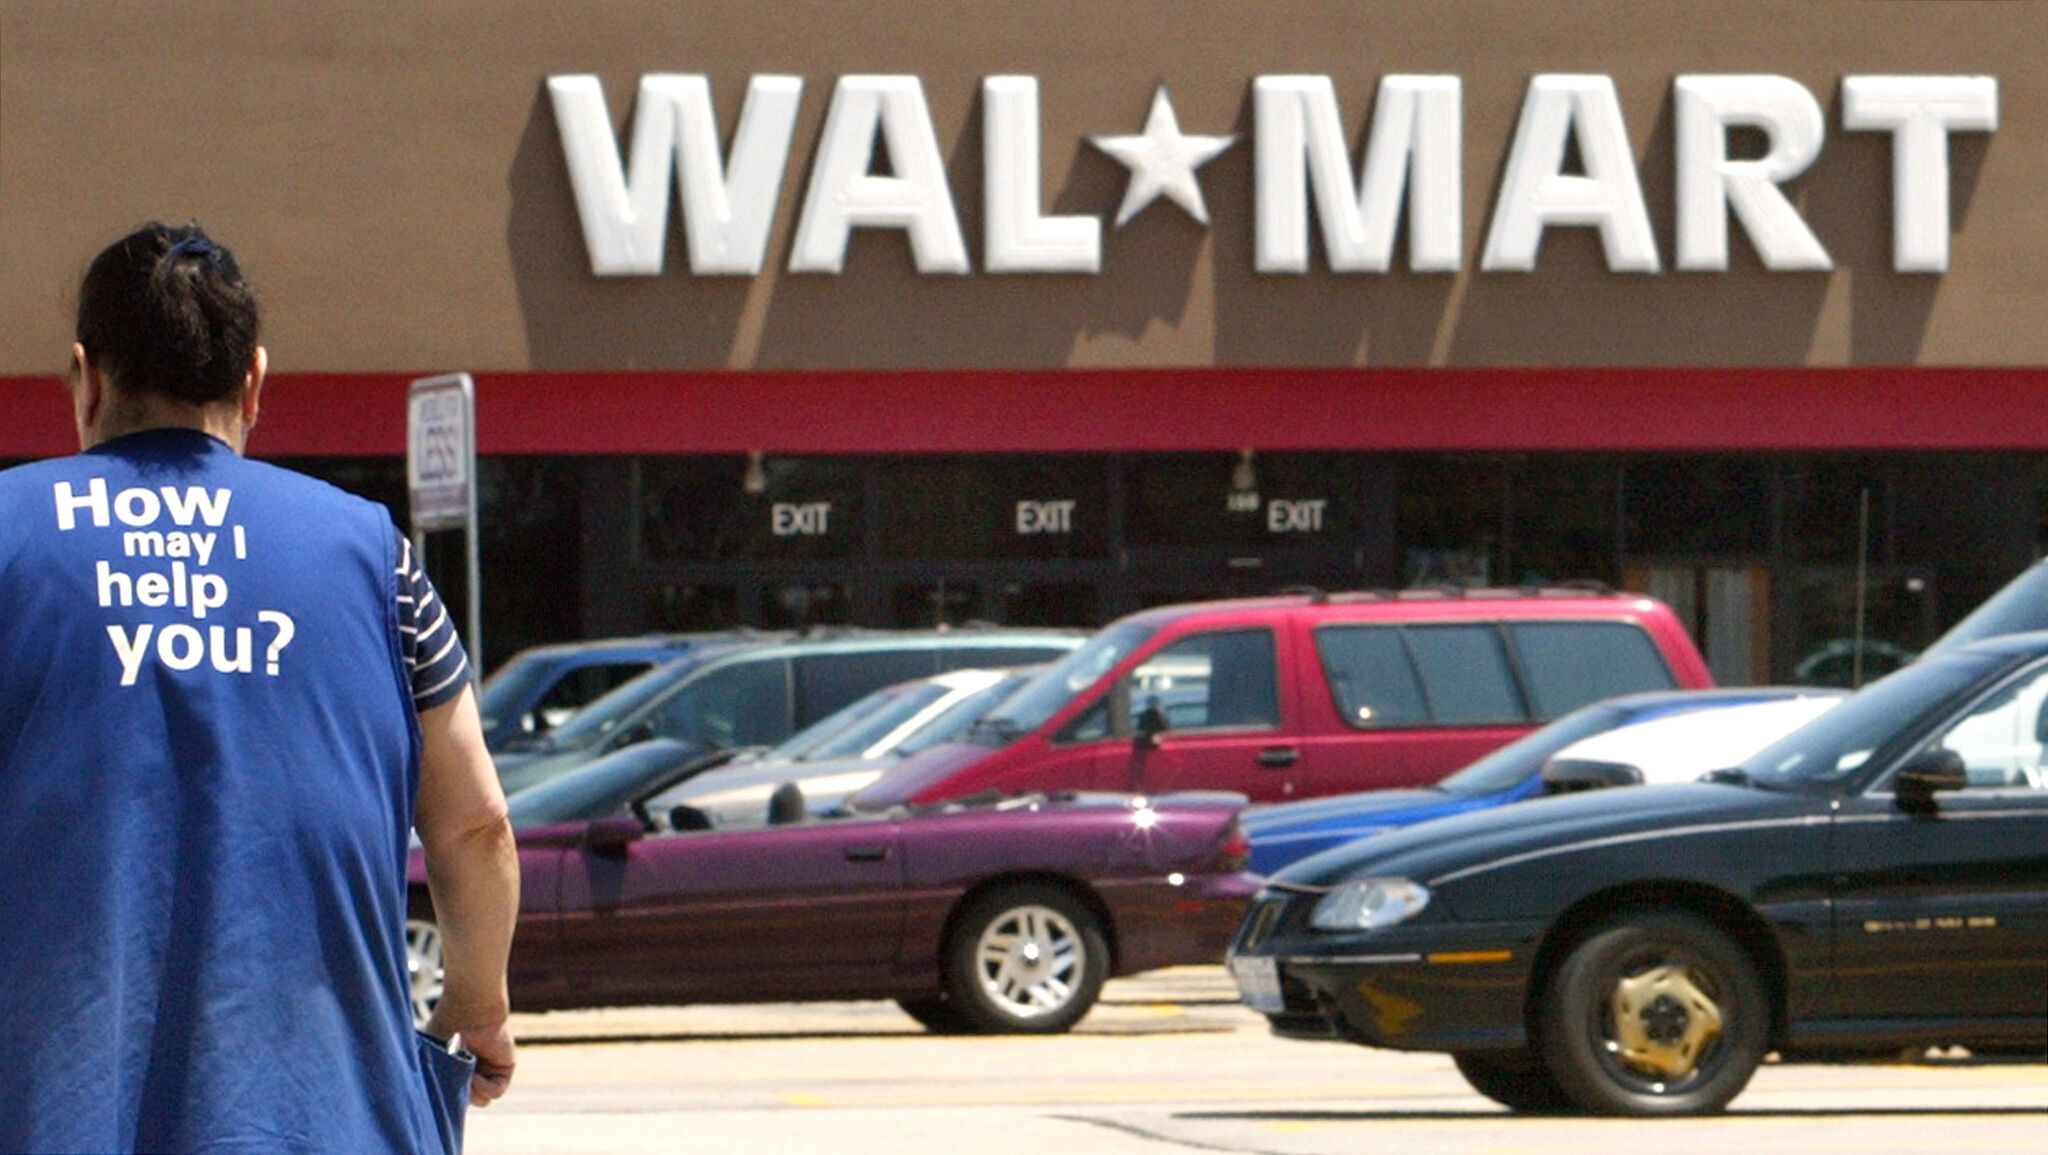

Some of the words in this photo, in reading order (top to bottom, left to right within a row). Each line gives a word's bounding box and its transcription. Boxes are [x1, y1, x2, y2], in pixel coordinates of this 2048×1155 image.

[54, 478, 231, 530] How
[772, 502, 831, 535] EXIT
[1016, 500, 1075, 533] EXIT
[1267, 498, 1327, 532] EXIT
[124, 531, 217, 566] may
[233, 525, 247, 560] I
[96, 560, 228, 619] help
[106, 610, 295, 687] you?
